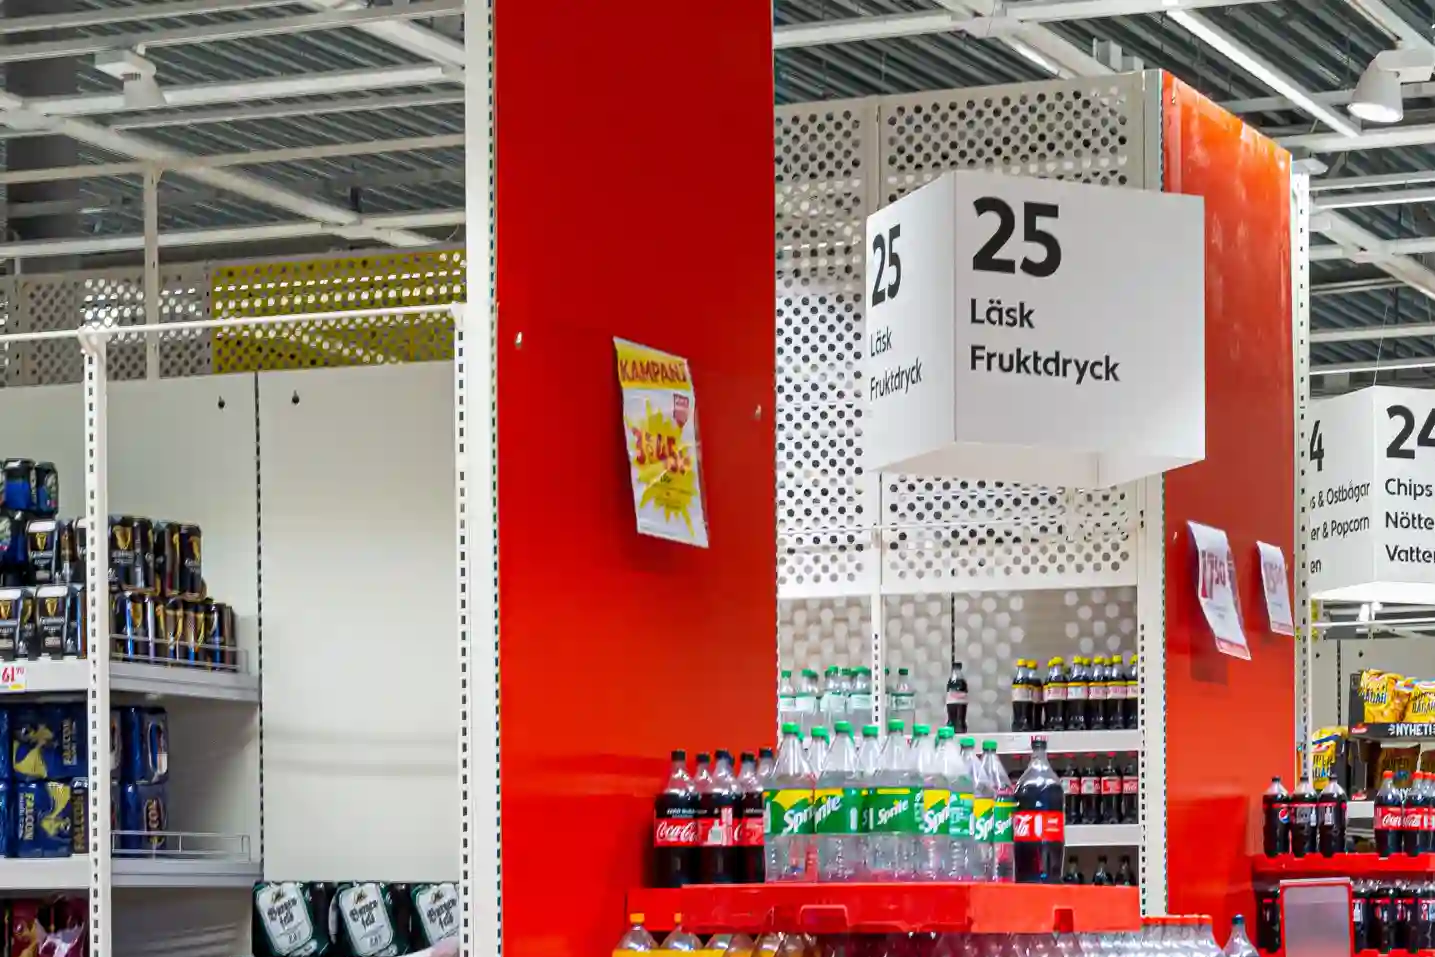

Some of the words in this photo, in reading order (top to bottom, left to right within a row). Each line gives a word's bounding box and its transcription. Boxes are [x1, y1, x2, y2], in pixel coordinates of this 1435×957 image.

[972, 196, 1062, 278] 25
[871, 223, 901, 308] 25
[970, 298, 1035, 329] Läsk
[870, 326, 892, 357] Läsk
[870, 357, 922, 400] Fruktdryck
[970, 345, 1121, 385] Fruktdryck
[1309, 419, 1325, 472] 4
[1326, 480, 1370, 506] Ostbågar
[1384, 478, 1433, 501] Chips
[1331, 515, 1370, 538] Popcorn
[1396, 723, 1432, 736] NYHET!
[813, 796, 843, 828] prite
[877, 799, 910, 826] Sprite
